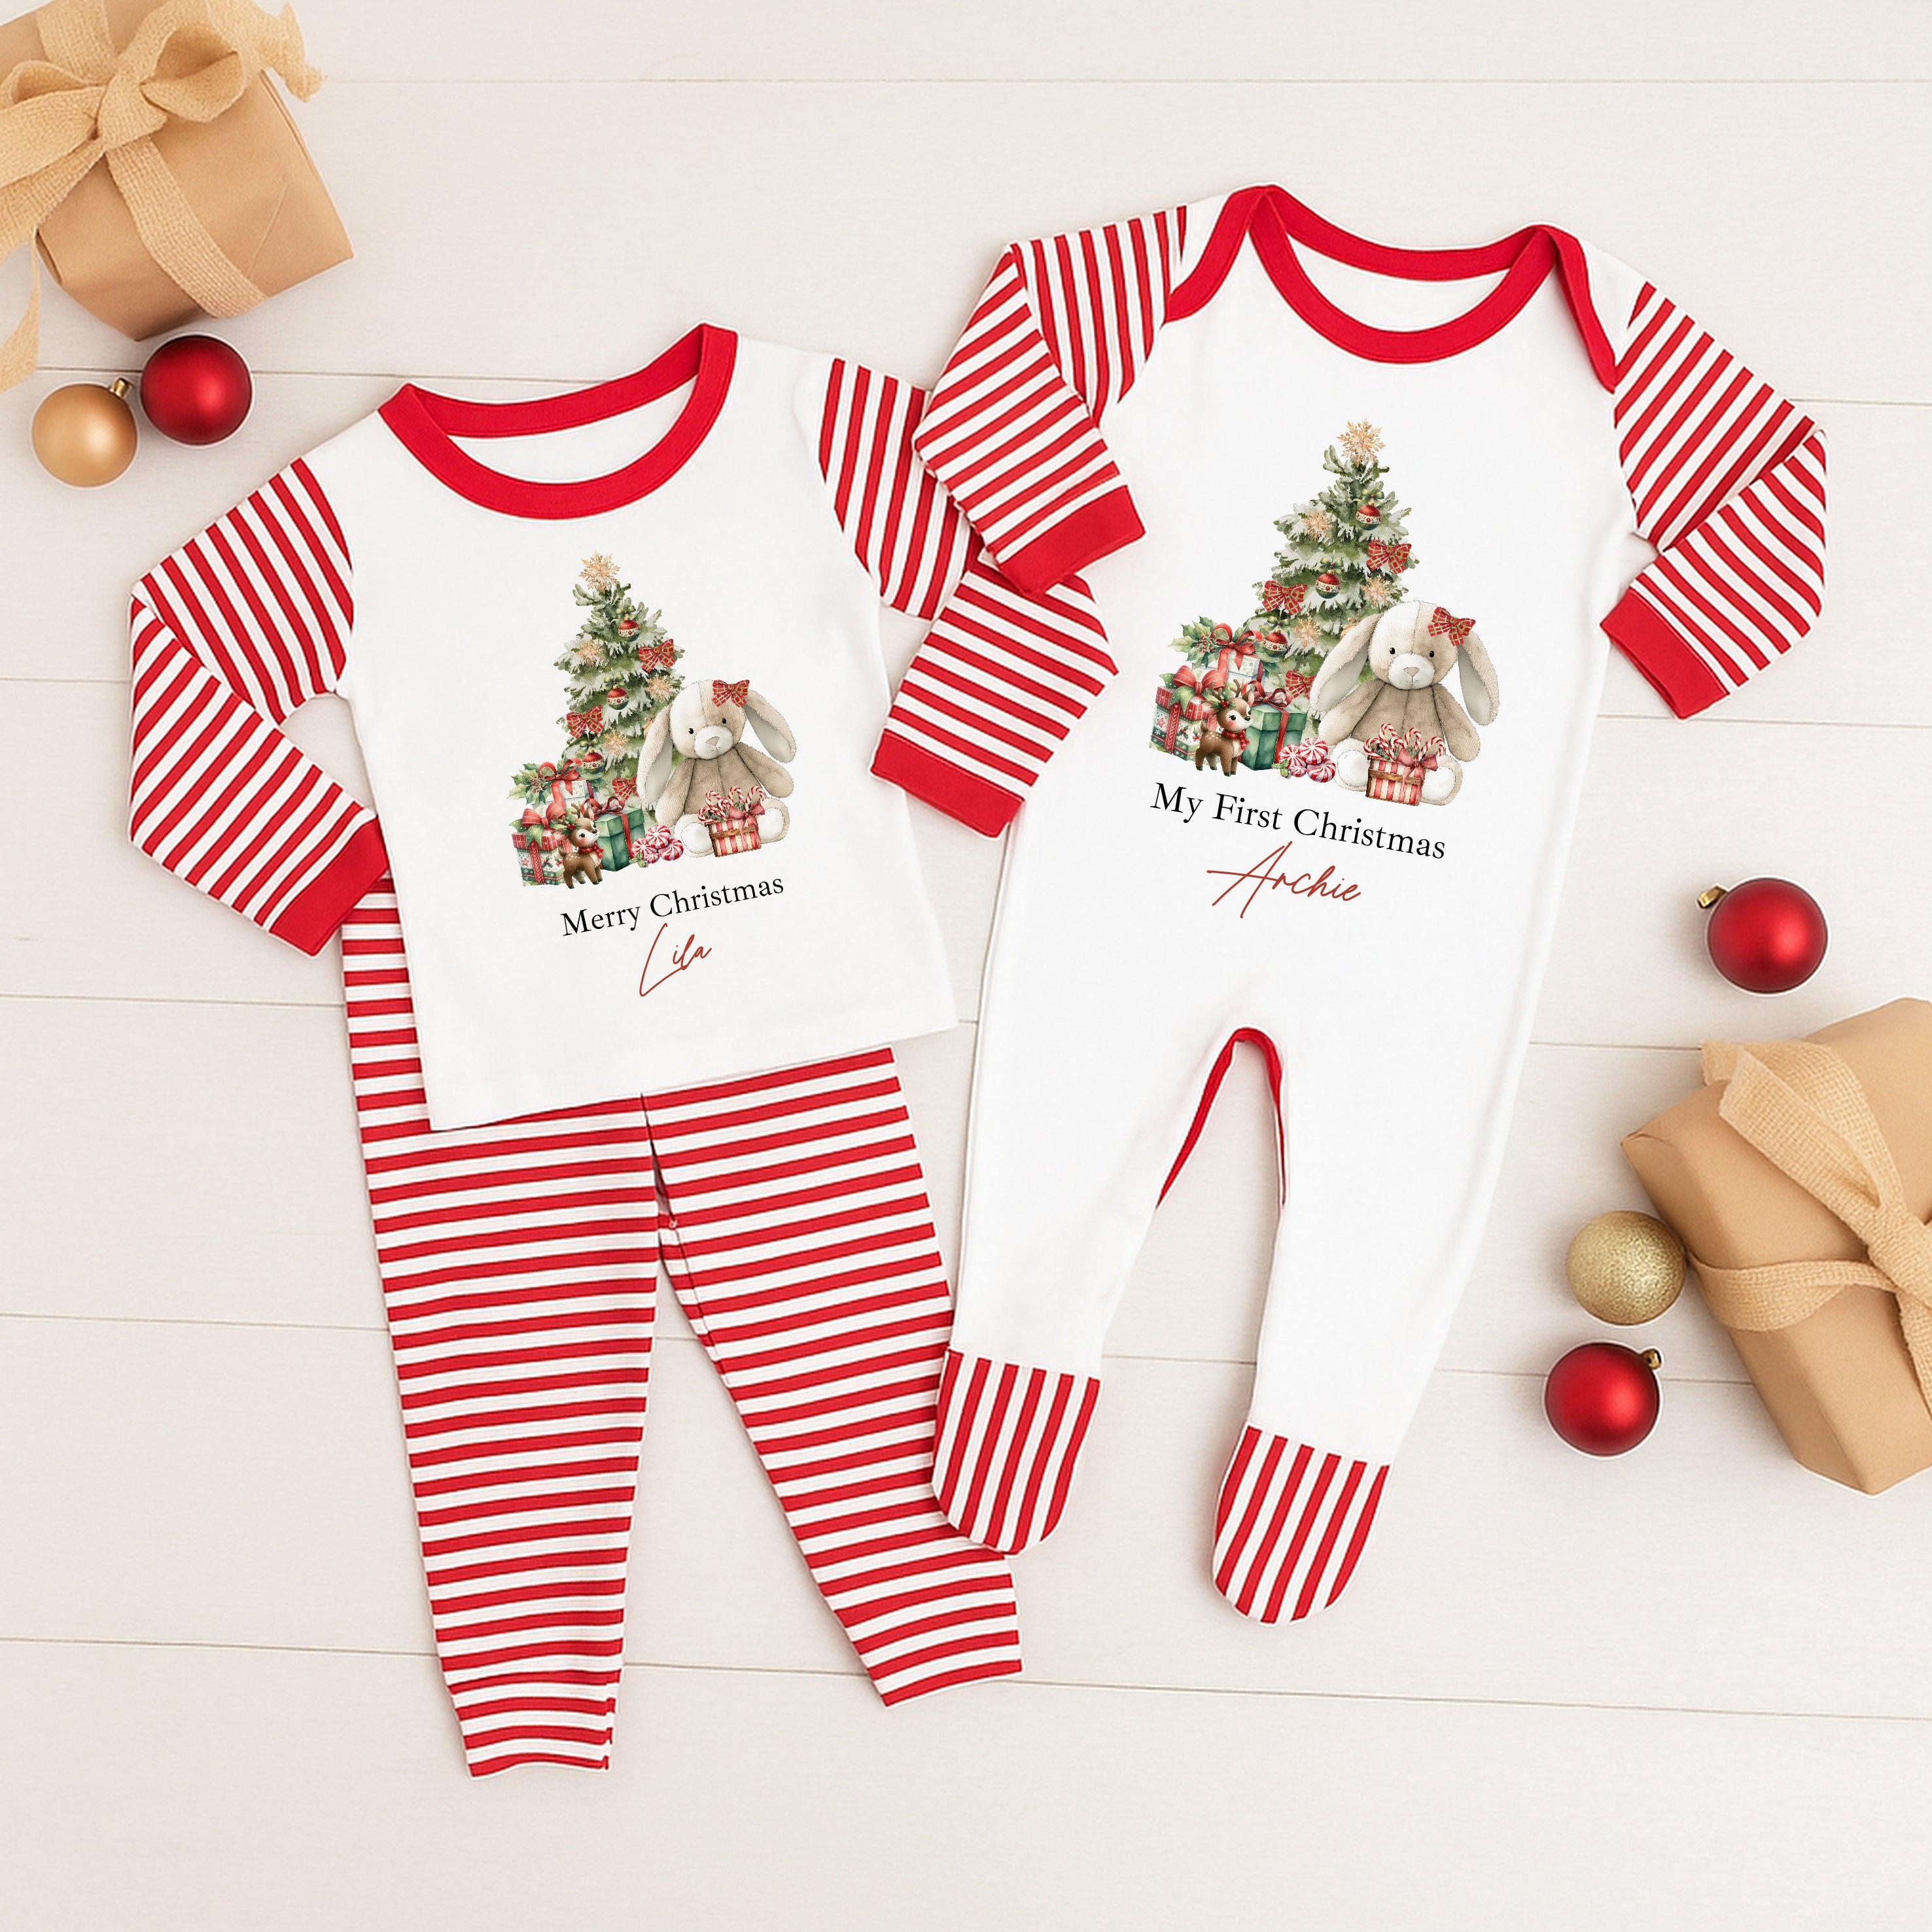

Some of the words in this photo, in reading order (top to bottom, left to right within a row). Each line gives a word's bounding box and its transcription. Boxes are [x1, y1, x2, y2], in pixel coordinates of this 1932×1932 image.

[1150, 782, 1204, 824] My
[1212, 793, 1284, 830] First
[1293, 809, 1445, 859] Christmas
[560, 906, 642, 937] Merry
[650, 878, 784, 917] Christmas
[1206, 840, 1361, 919] Archie
[639, 922, 712, 998] Lila
